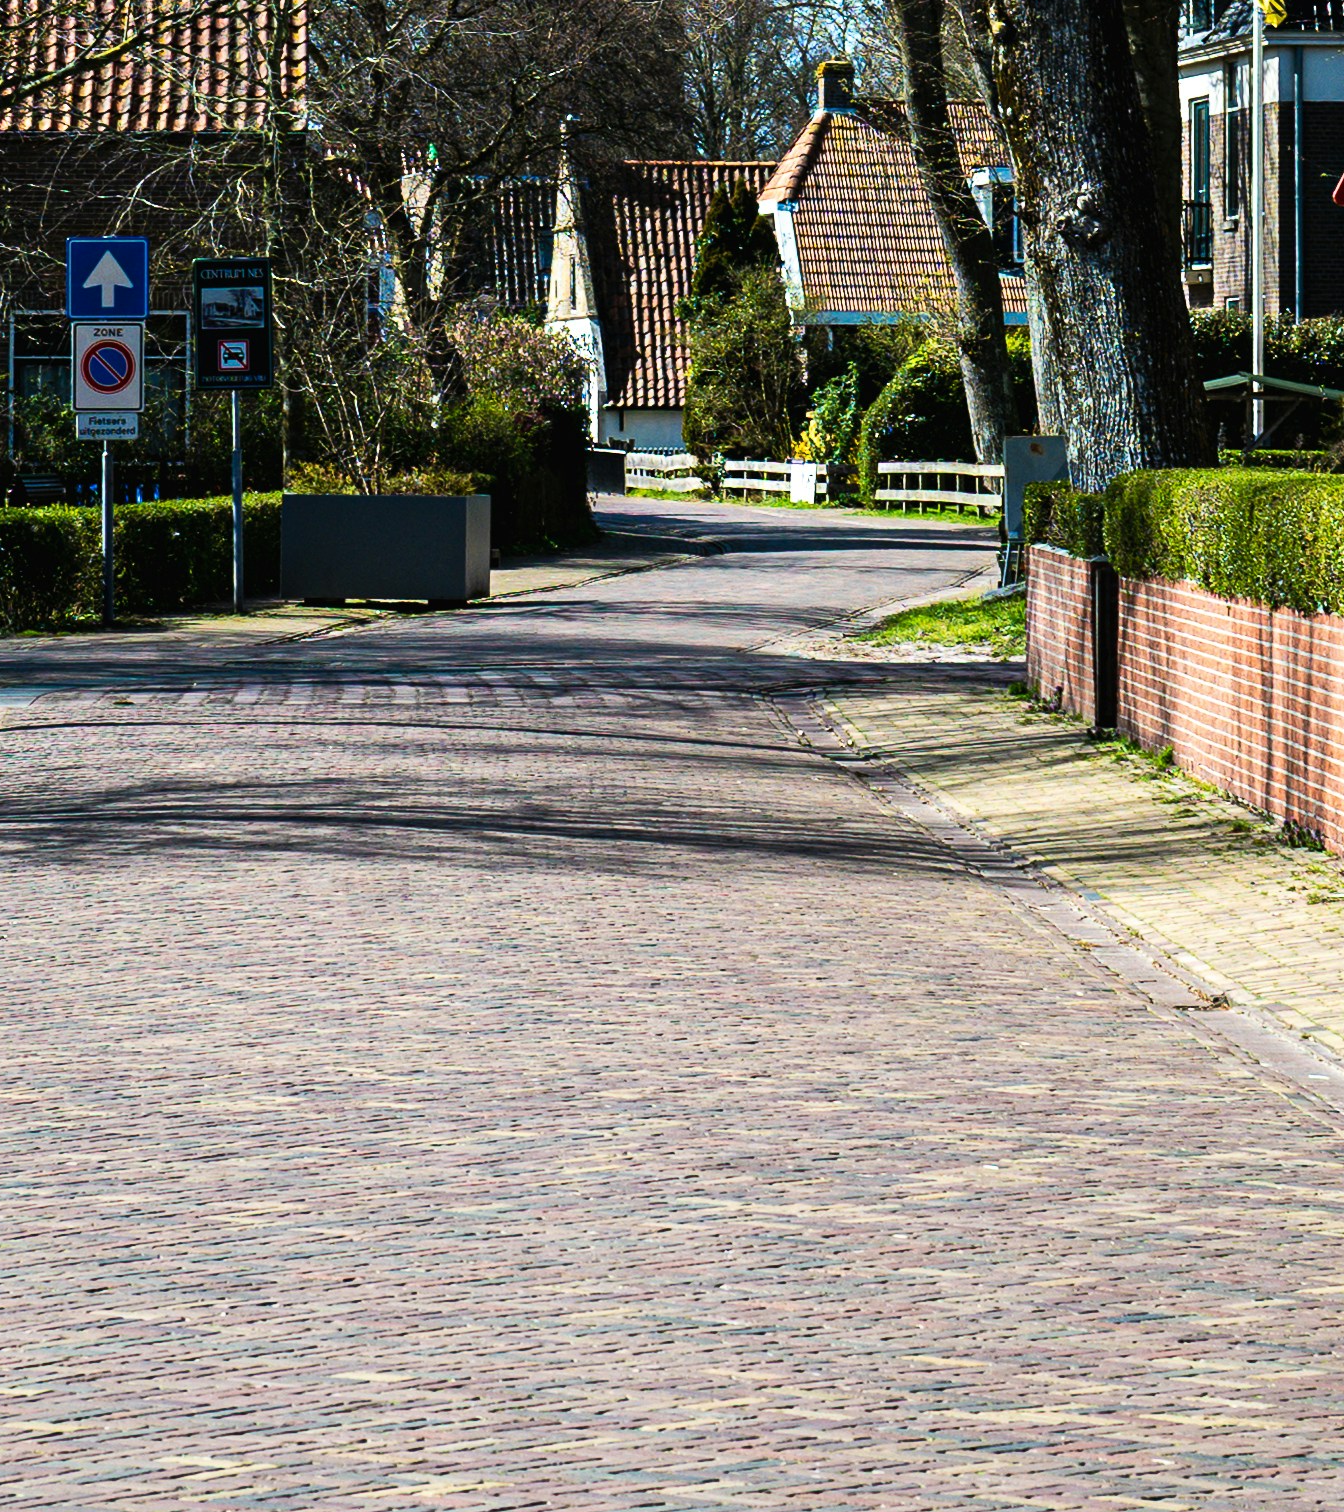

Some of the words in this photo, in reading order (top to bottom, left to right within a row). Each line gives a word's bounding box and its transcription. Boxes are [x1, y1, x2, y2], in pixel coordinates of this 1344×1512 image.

[247, 268, 264, 278] NES
[93, 327, 124, 337] ZONE
[88, 416, 127, 426] Fietsers
[79, 426, 136, 437] uitgezonderd
